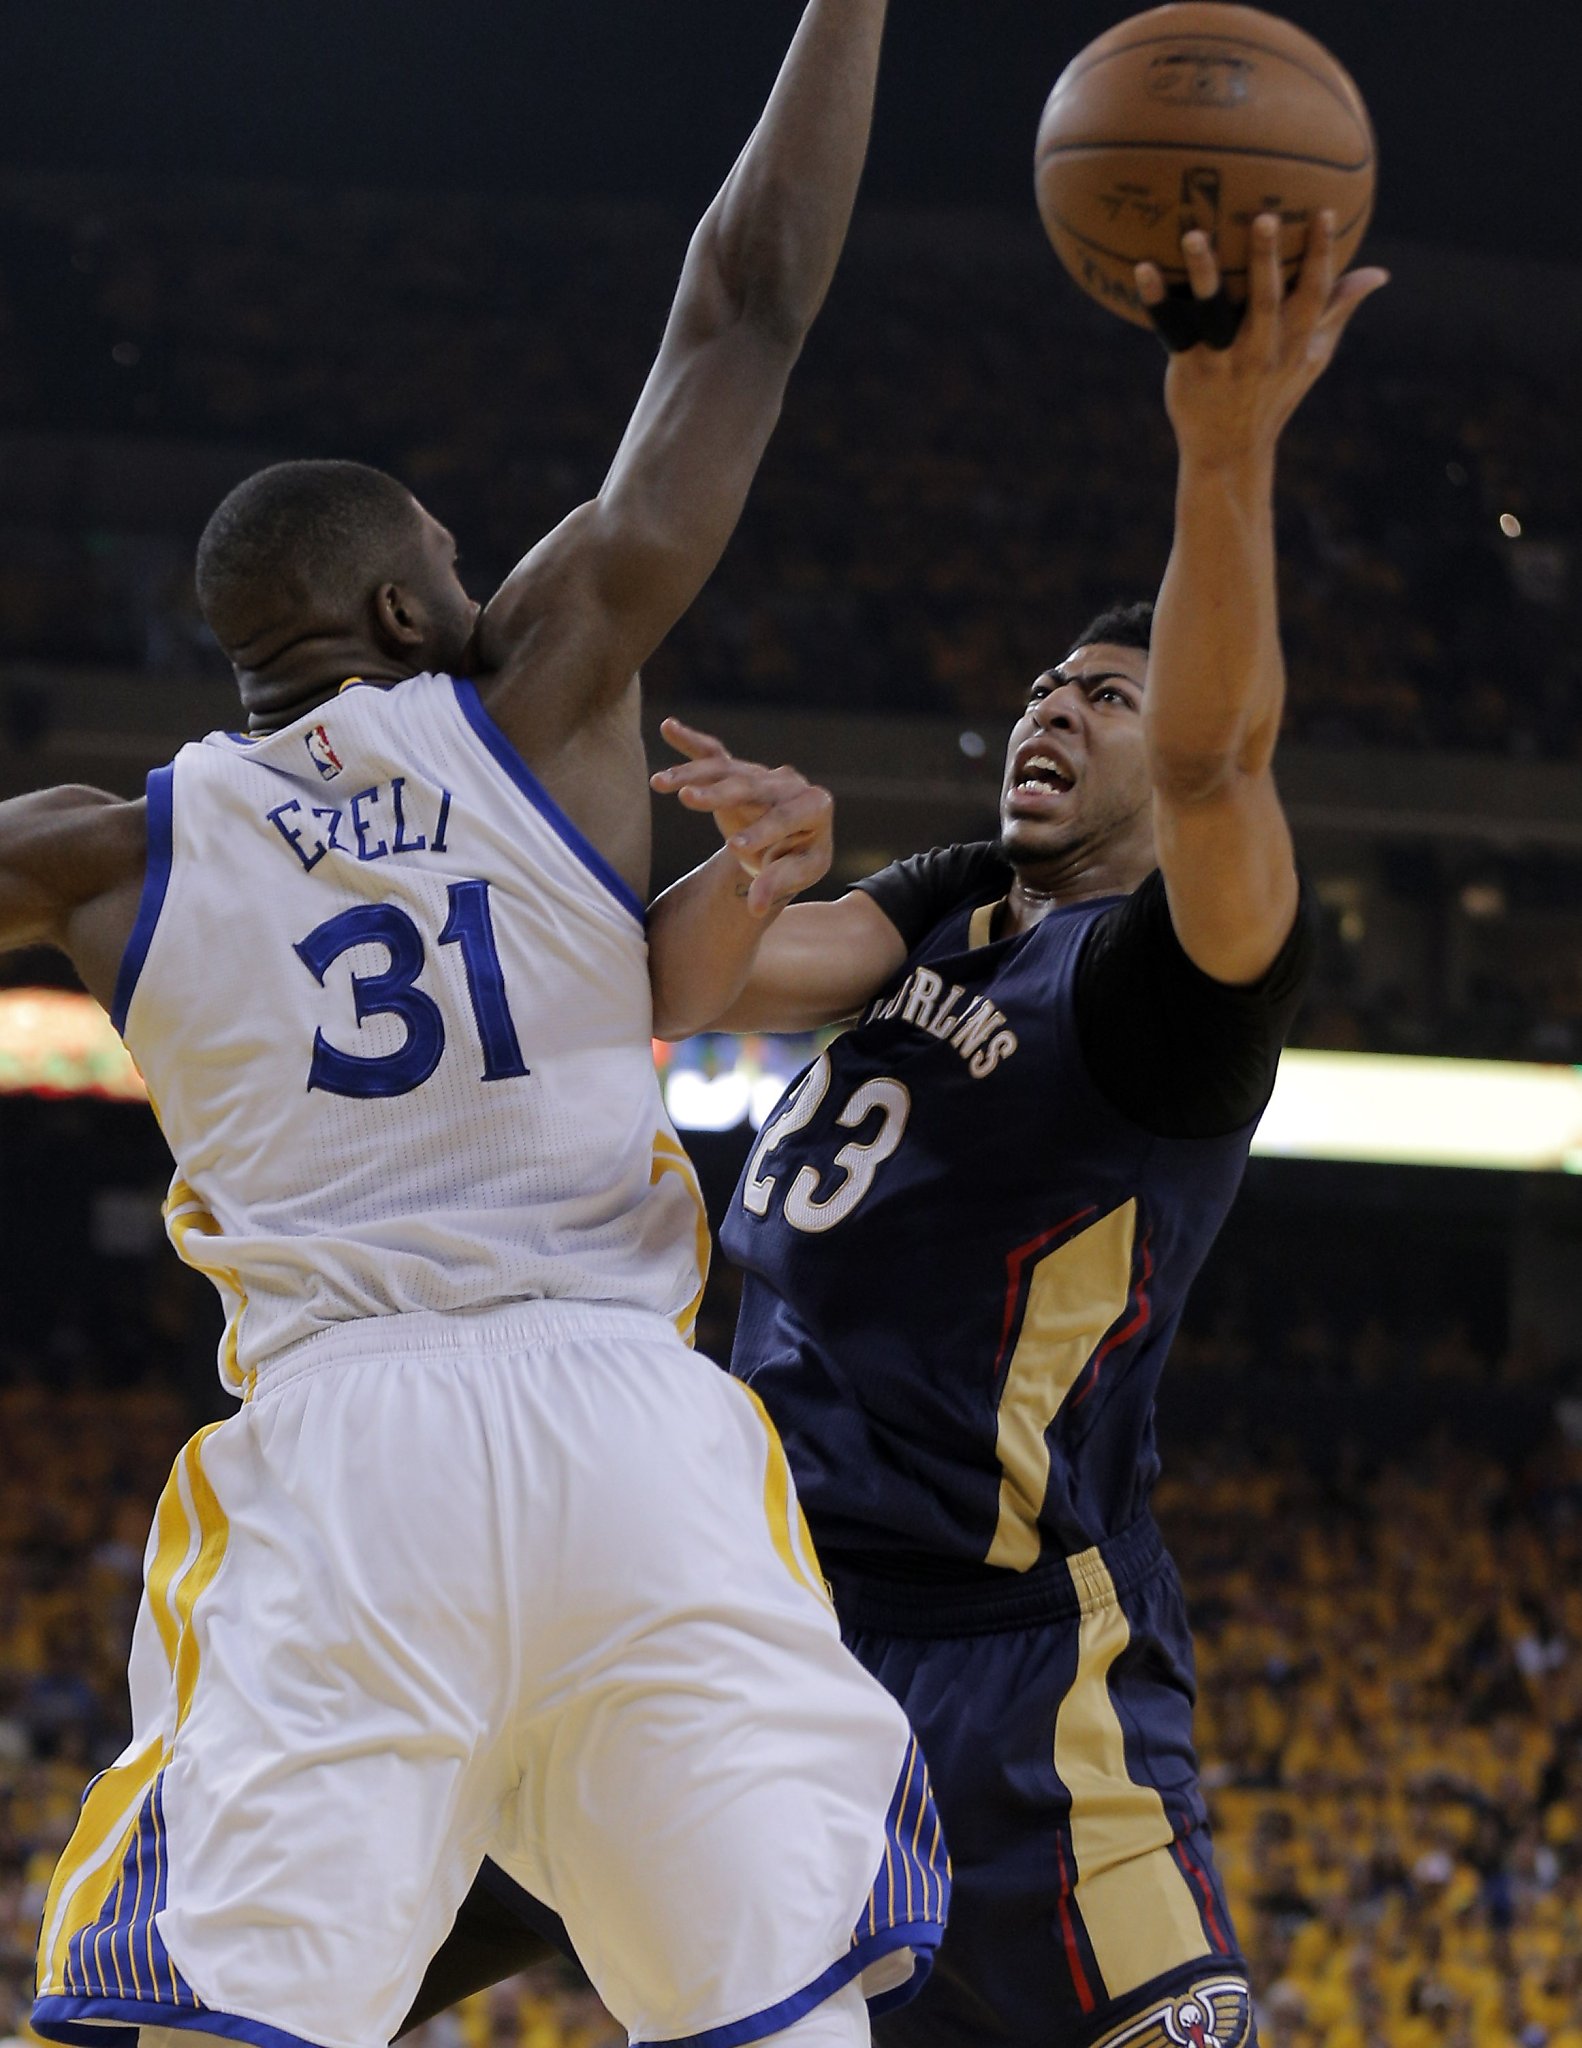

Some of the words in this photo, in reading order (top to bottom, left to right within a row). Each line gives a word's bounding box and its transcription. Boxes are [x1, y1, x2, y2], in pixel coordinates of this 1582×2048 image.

[267, 777, 452, 872] EZELI
[292, 880, 531, 1099] 31
[743, 1050, 911, 1233] 23
